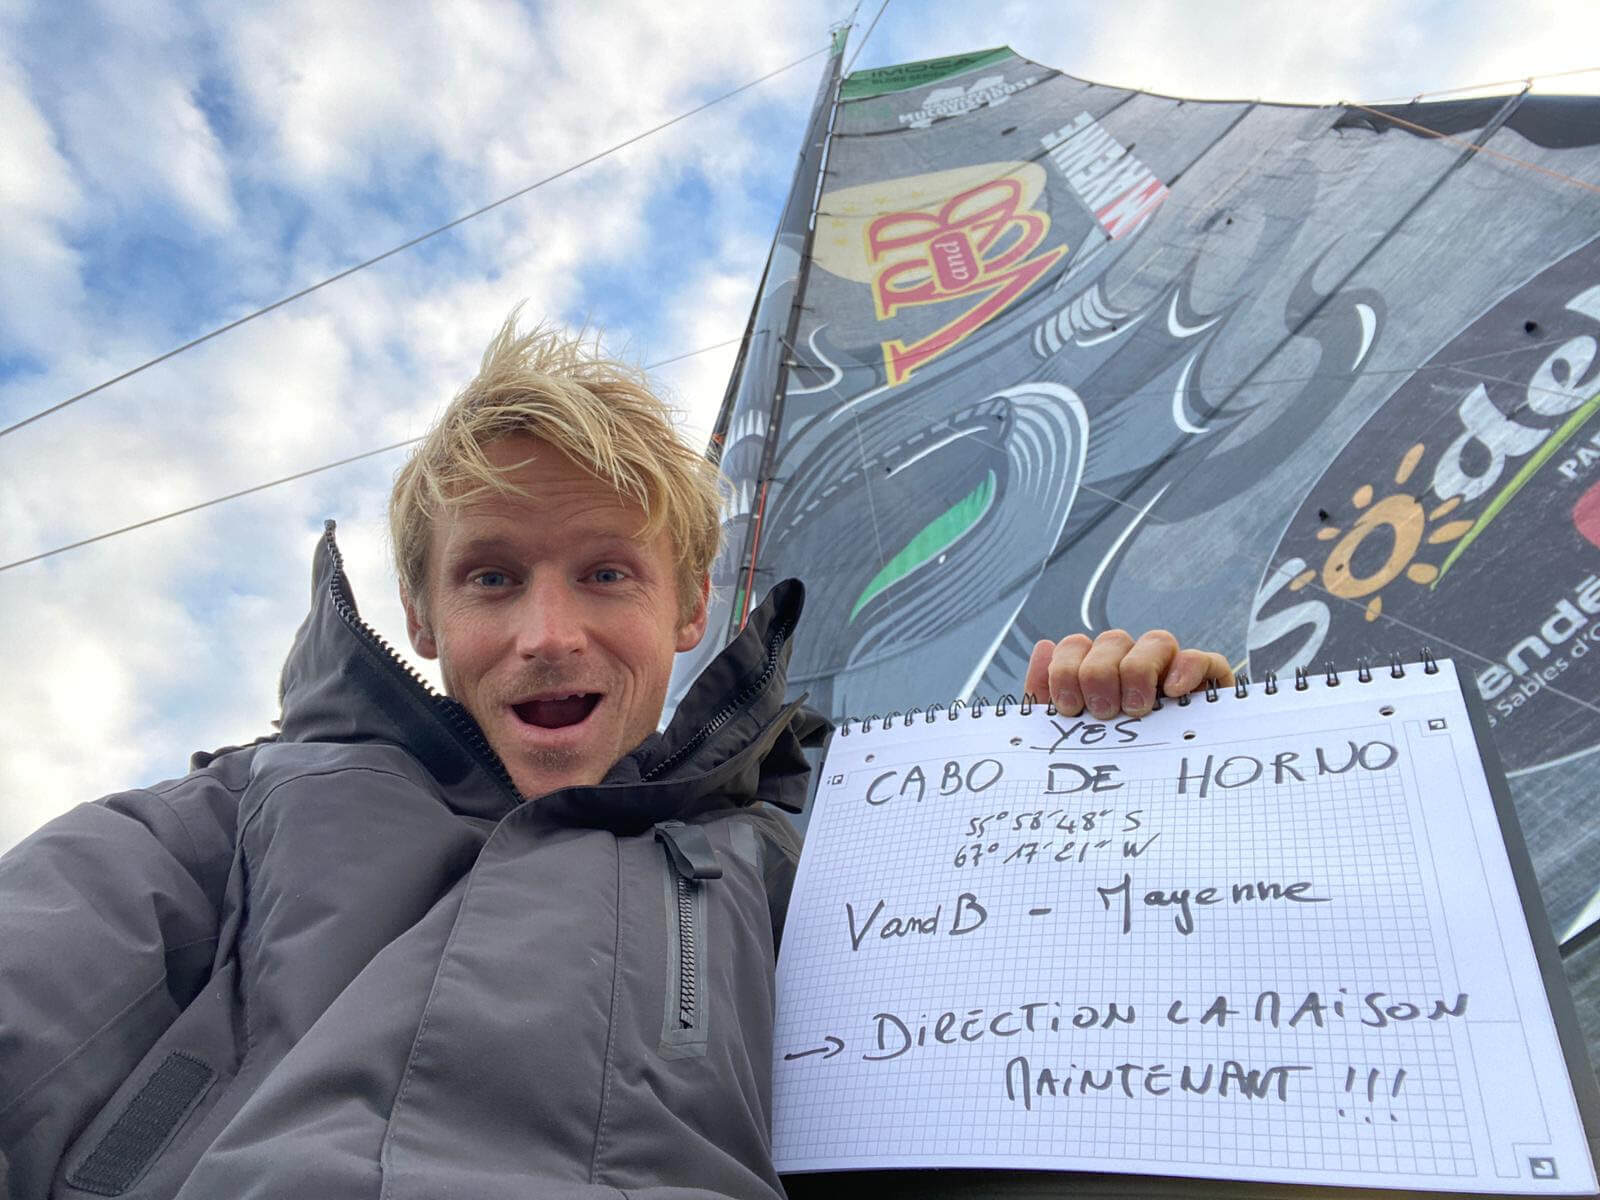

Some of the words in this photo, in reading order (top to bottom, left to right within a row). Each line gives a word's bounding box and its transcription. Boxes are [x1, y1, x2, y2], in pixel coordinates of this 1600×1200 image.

[1040, 110, 1169, 241] MAYENNE
[1497, 656, 1569, 718] Sables
[1048, 718, 1142, 755] YES
[865, 758, 1004, 805] CABO
[1043, 763, 1126, 795] DE
[1177, 740, 1398, 798] HORNO
[1121, 809, 1144, 832] S
[1123, 832, 1161, 859] W
[1097, 873, 1333, 936] Mayenne
[1337, 1066, 1408, 1125] !!!
